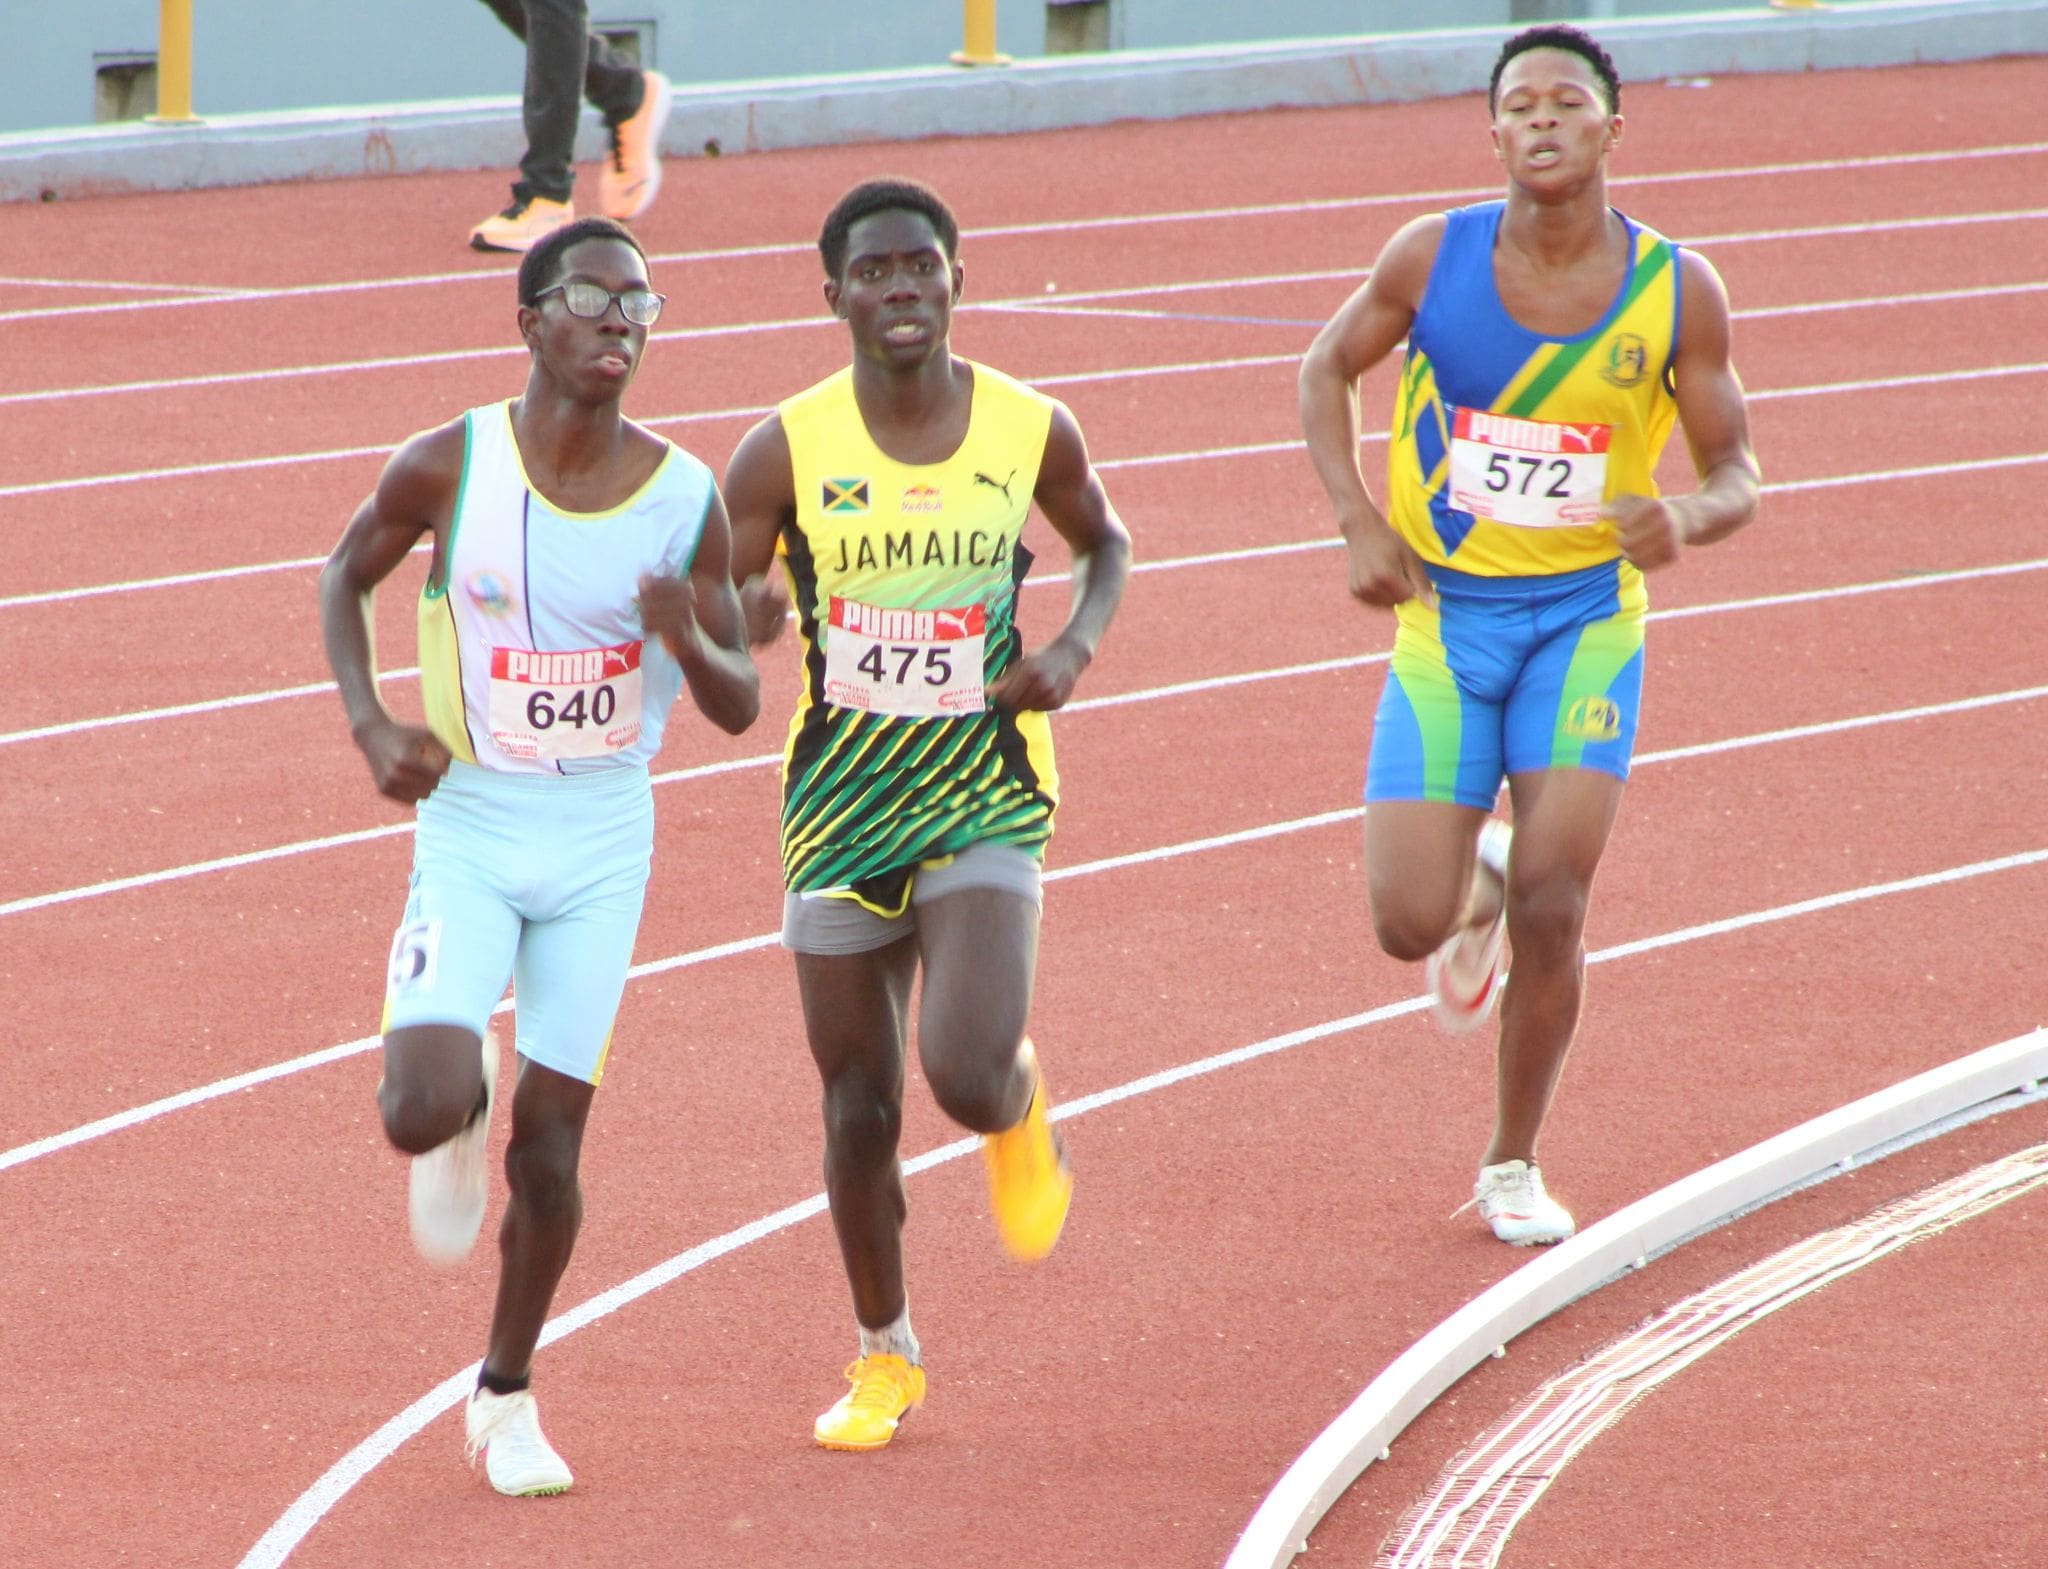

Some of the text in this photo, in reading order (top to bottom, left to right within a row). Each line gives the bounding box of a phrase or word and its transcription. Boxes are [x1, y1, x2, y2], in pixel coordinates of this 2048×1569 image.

[1469, 411, 1561, 452] PUMA
[1485, 452, 1572, 498] 572
[834, 530, 1008, 573] JAMAICA
[842, 600, 935, 640] PUMA
[507, 650, 604, 684] PUMA
[857, 644, 952, 686] 475
[527, 684, 616, 730] 640
